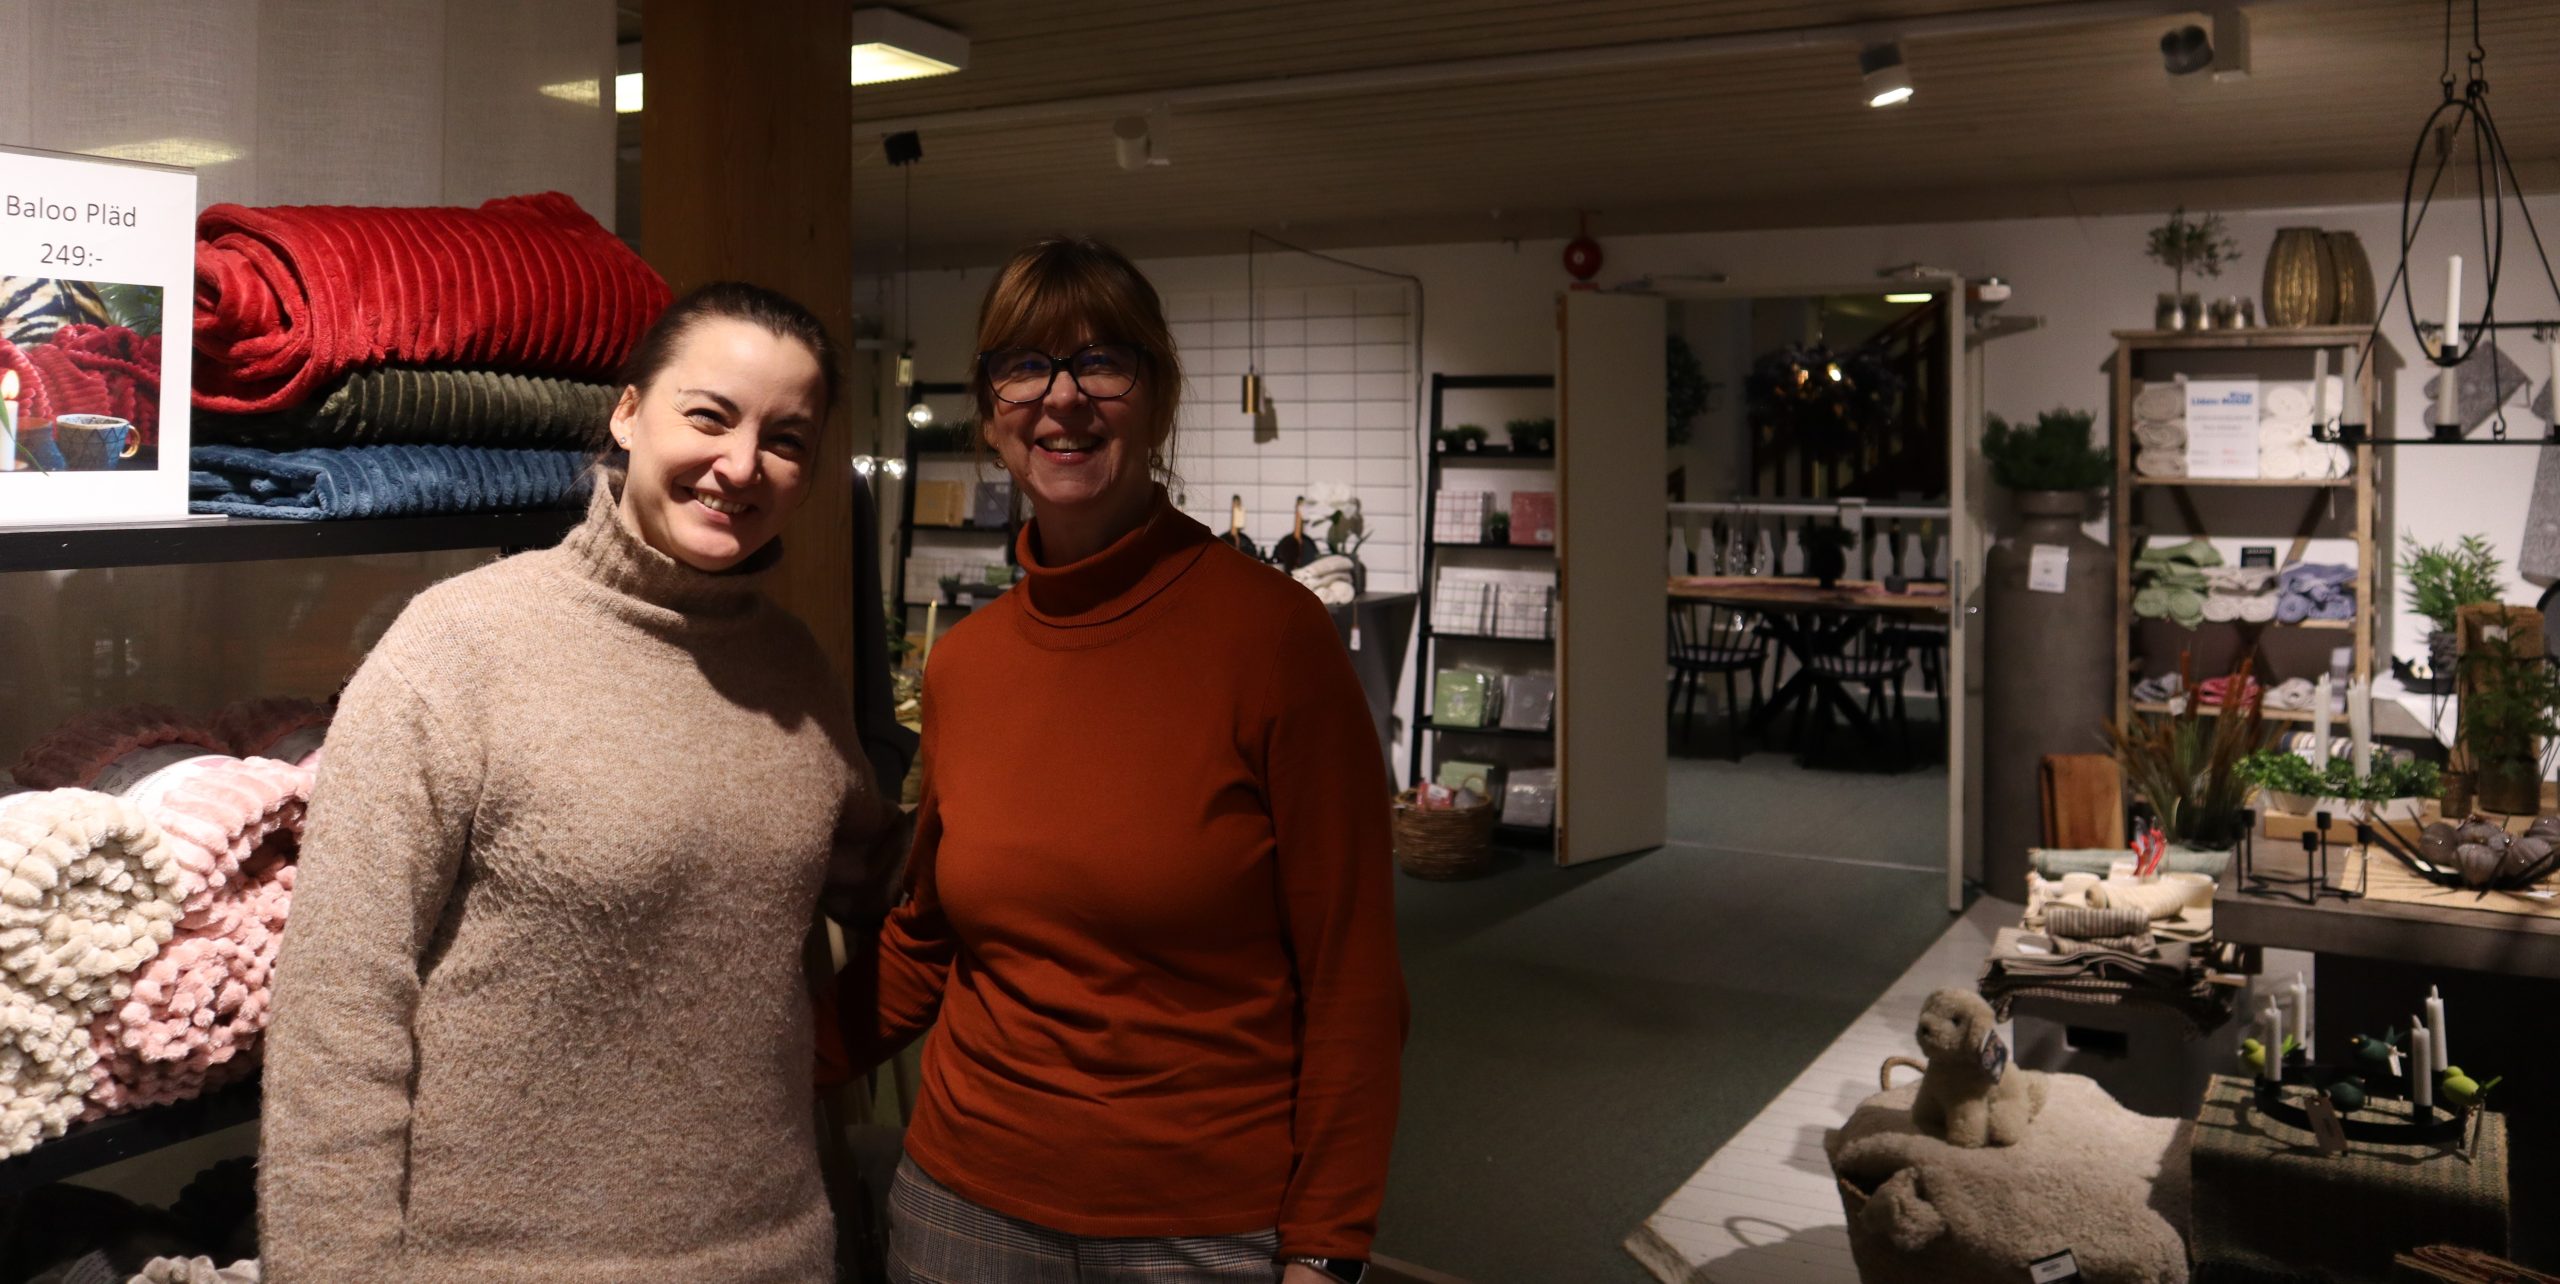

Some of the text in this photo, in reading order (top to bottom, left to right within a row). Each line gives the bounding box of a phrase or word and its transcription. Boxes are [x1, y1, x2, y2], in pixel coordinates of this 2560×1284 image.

[6, 194, 137, 228] Baloo Pläd
[40, 242, 104, 268] 249:-
